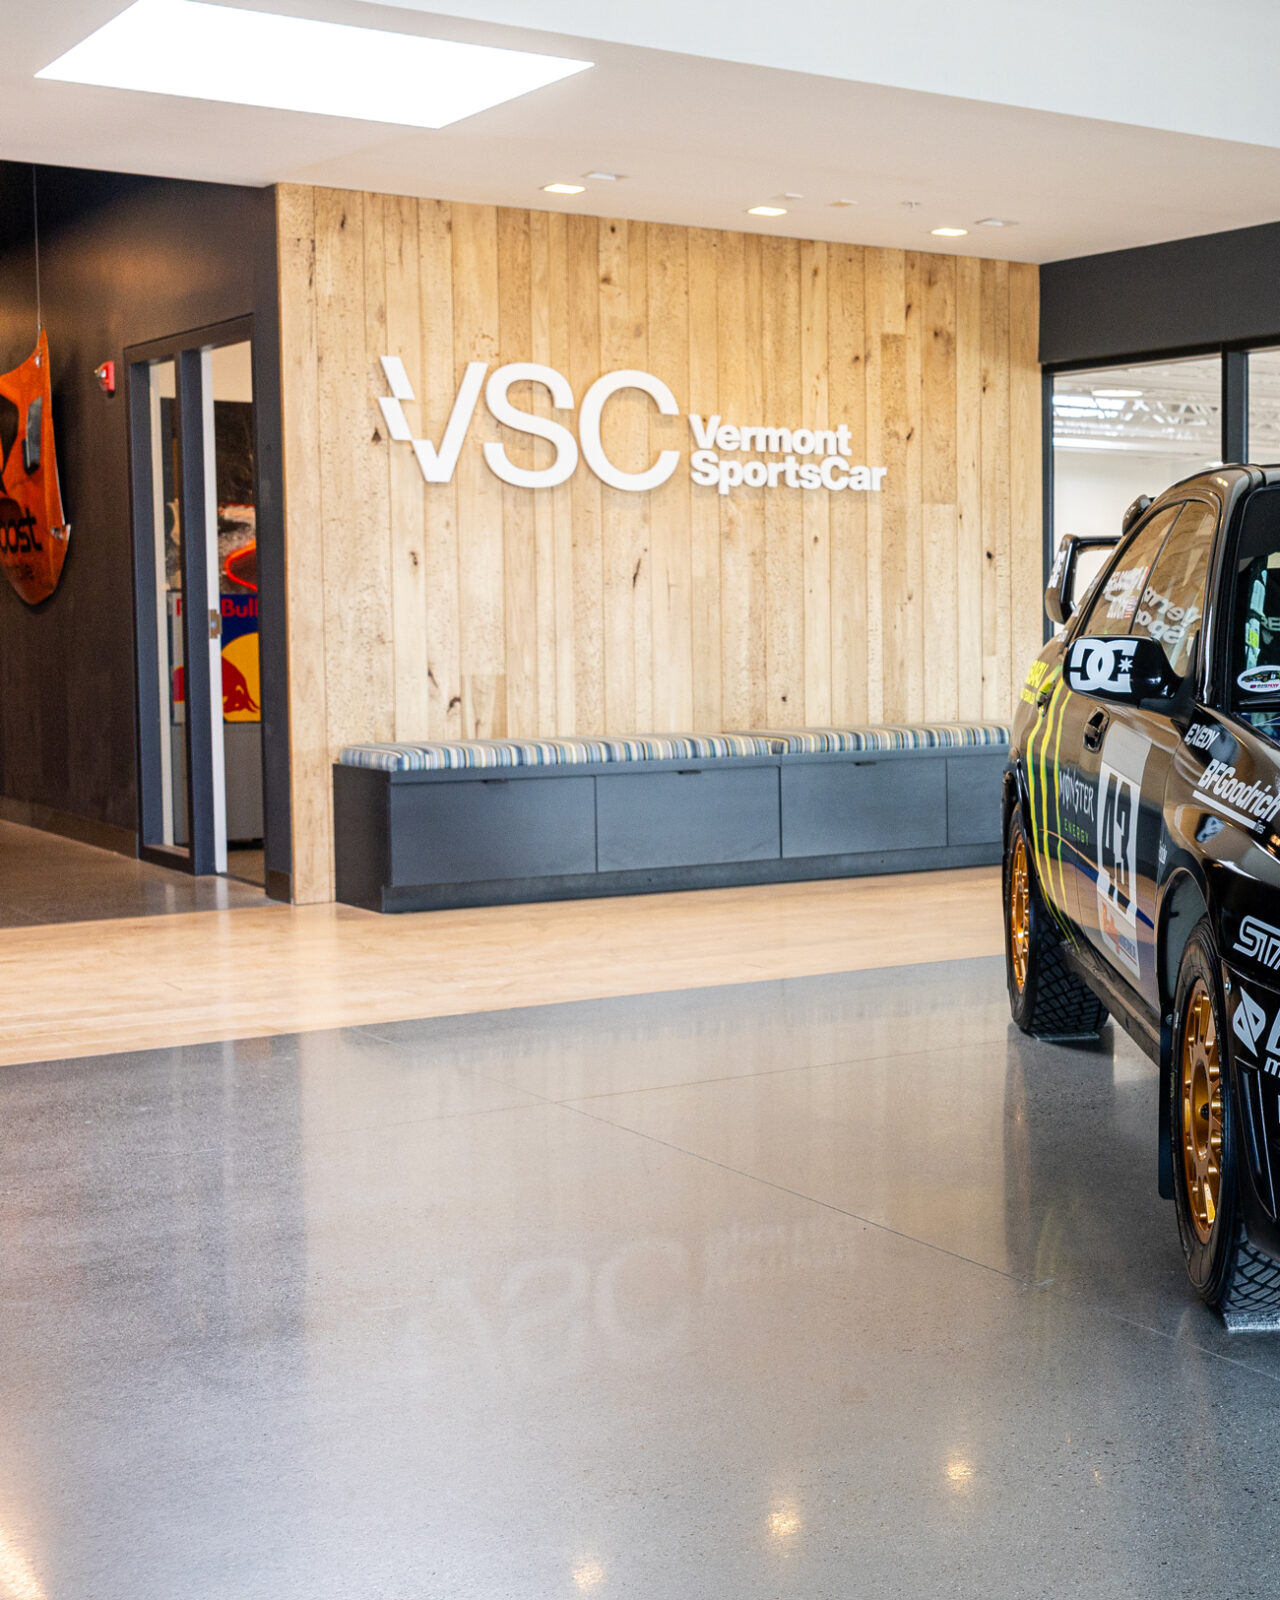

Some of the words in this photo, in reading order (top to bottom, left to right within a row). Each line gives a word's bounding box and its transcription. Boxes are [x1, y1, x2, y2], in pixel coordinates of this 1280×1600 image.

[378, 356, 680, 491] VSC
[689, 414, 852, 456] Vermont
[690, 450, 887, 495] SportsCar
[1184, 723, 1220, 751] EXEDY
[1059, 768, 1095, 823] MONSTER
[1198, 758, 1280, 823] BFGoodrich
[1064, 817, 1089, 846] ENERGY
